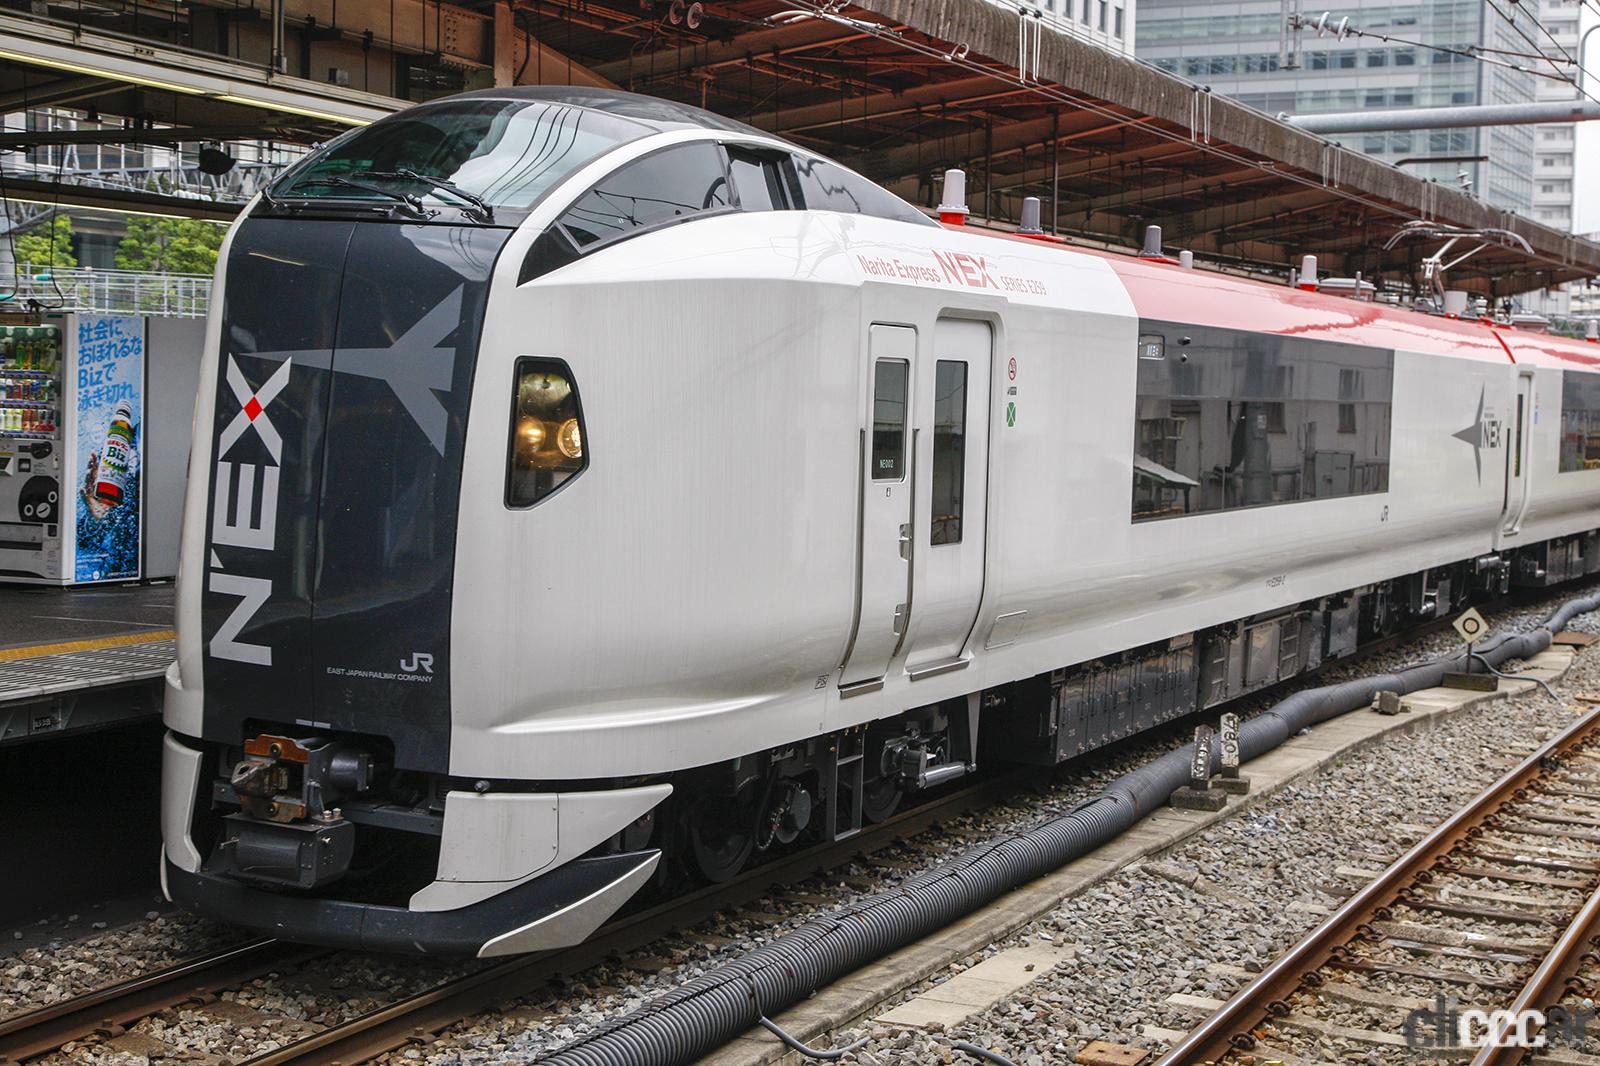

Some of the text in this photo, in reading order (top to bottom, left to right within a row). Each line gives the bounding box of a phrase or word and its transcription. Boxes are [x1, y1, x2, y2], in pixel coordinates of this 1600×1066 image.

[857, 254, 896, 277] Narita
[893, 259, 941, 284] Express
[1000, 275, 1029, 293] SERIES
[1027, 279, 1047, 296] E259
[79, 335, 142, 366] おぼれるな
[107, 446, 126, 463] Biz
[1380, 504, 1390, 522] JR
[400, 652, 434, 674] JR
[326, 666, 433, 683] EAST JAPAN RAILWAY COMPANY
